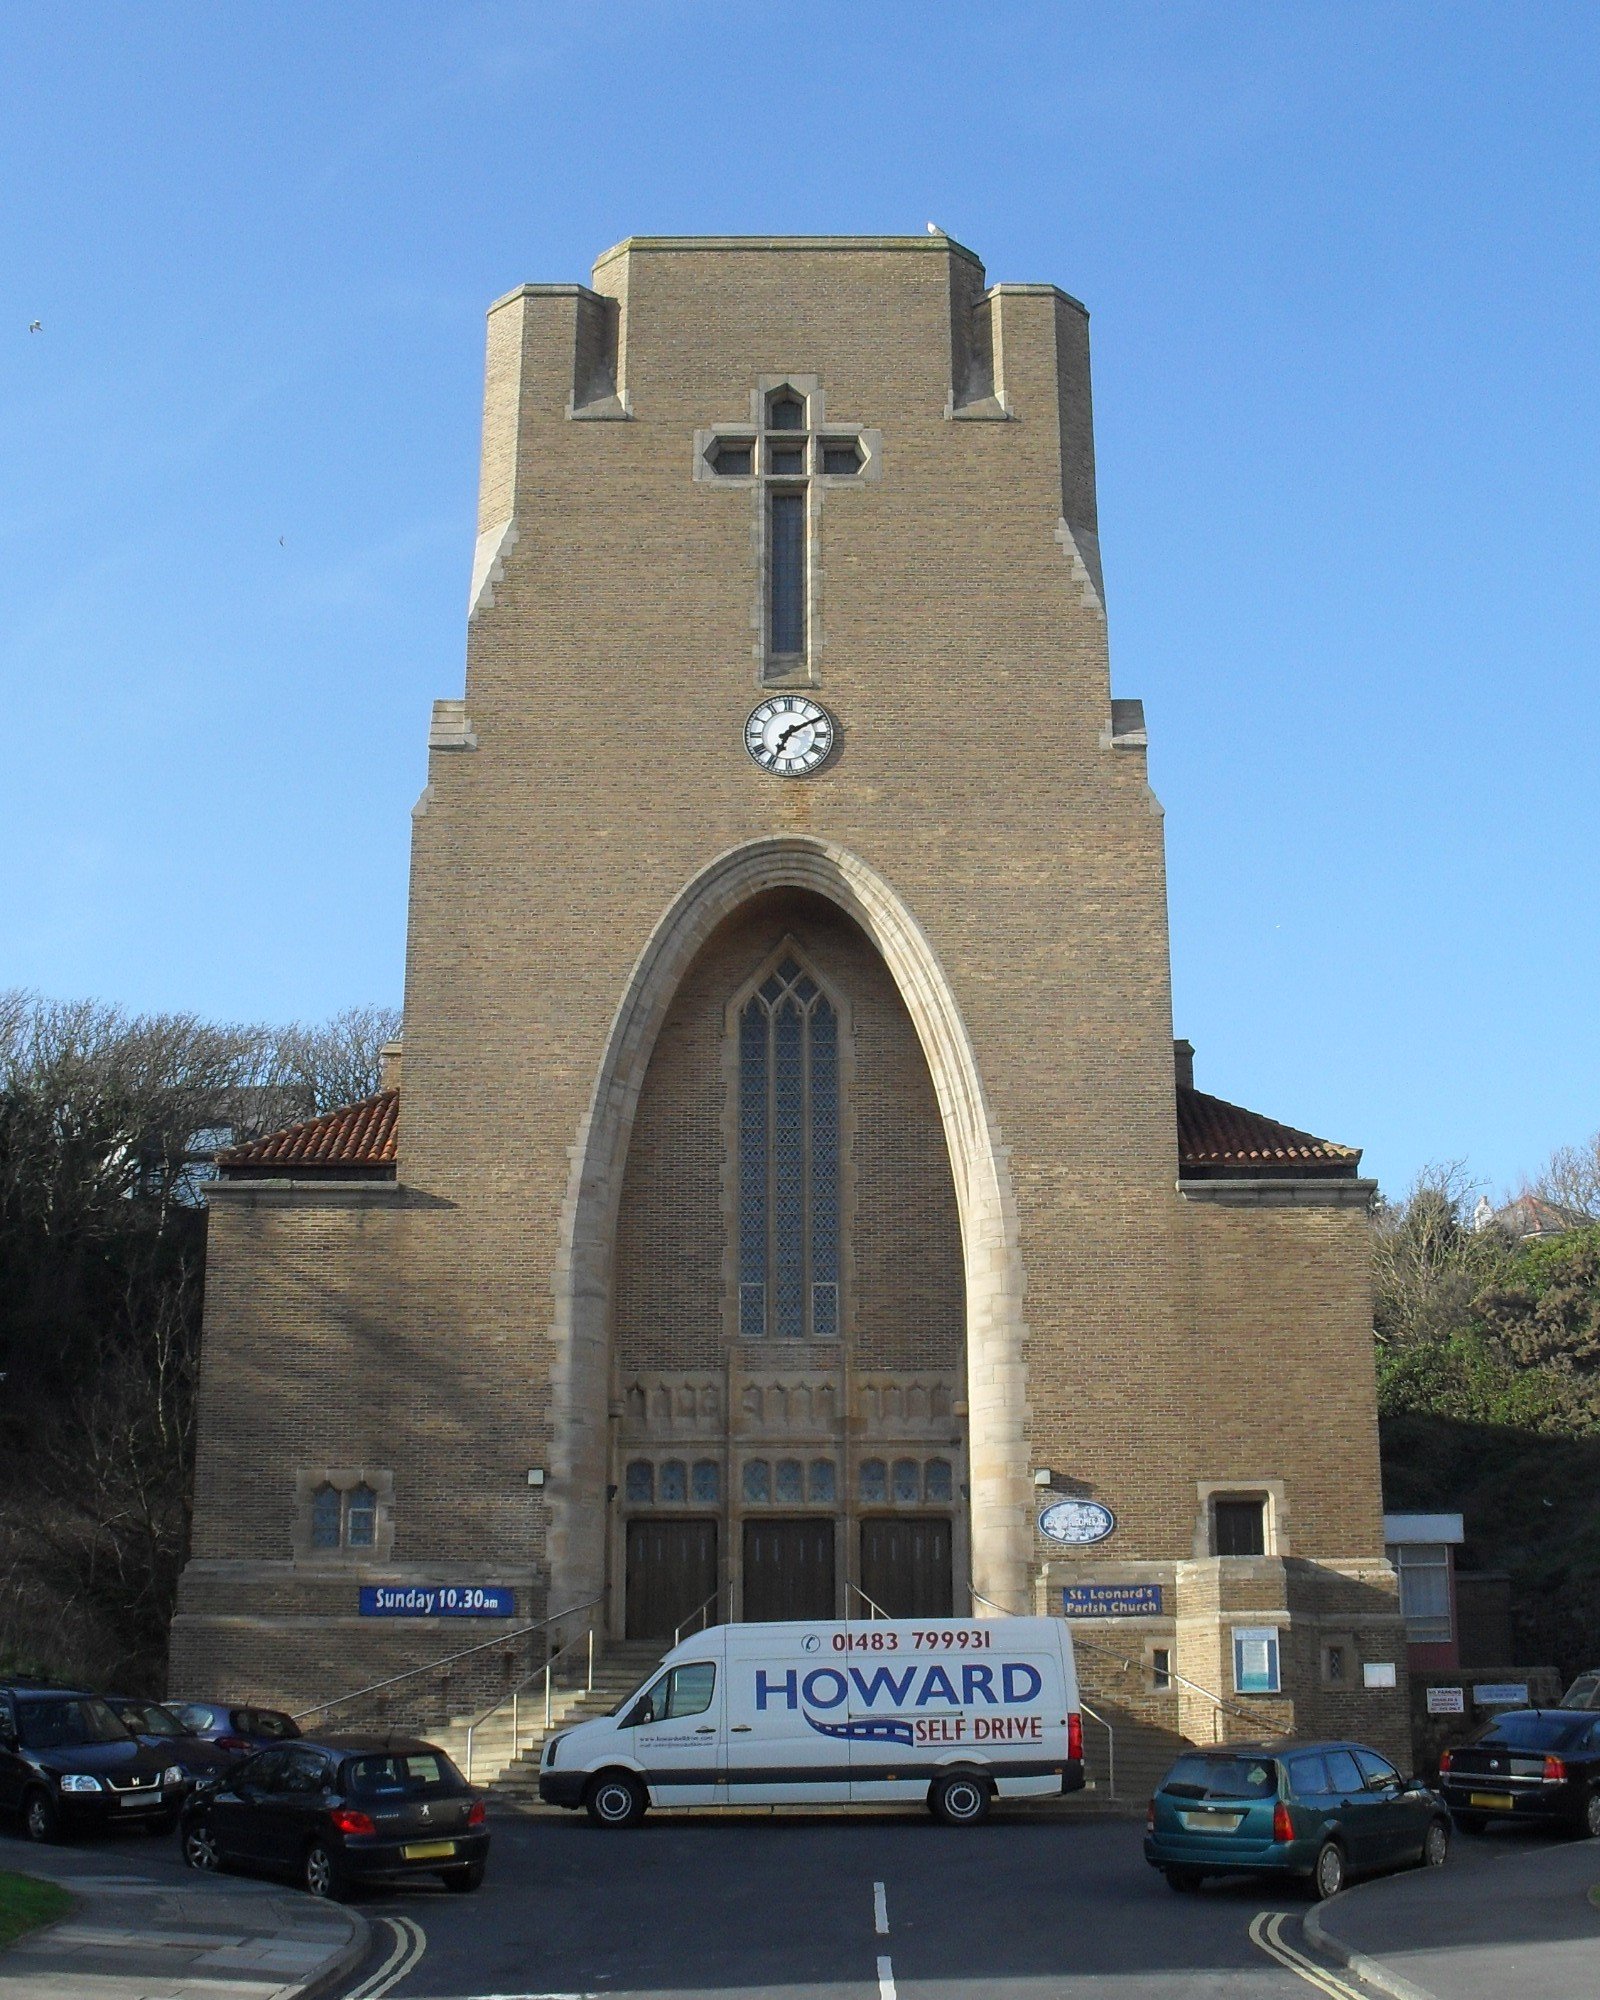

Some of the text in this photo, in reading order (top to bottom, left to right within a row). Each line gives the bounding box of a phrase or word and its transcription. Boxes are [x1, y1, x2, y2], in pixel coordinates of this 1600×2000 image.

[376, 1588, 435, 1613] Sunday
[1069, 1587, 1153, 1600] St. Leonard's
[1066, 1601, 1157, 1613] Parish Church
[832, 1630, 991, 1652] 01483 799931
[755, 1663, 1042, 1711] HOWARD
[916, 1717, 1043, 1742] SELF DRIVE
